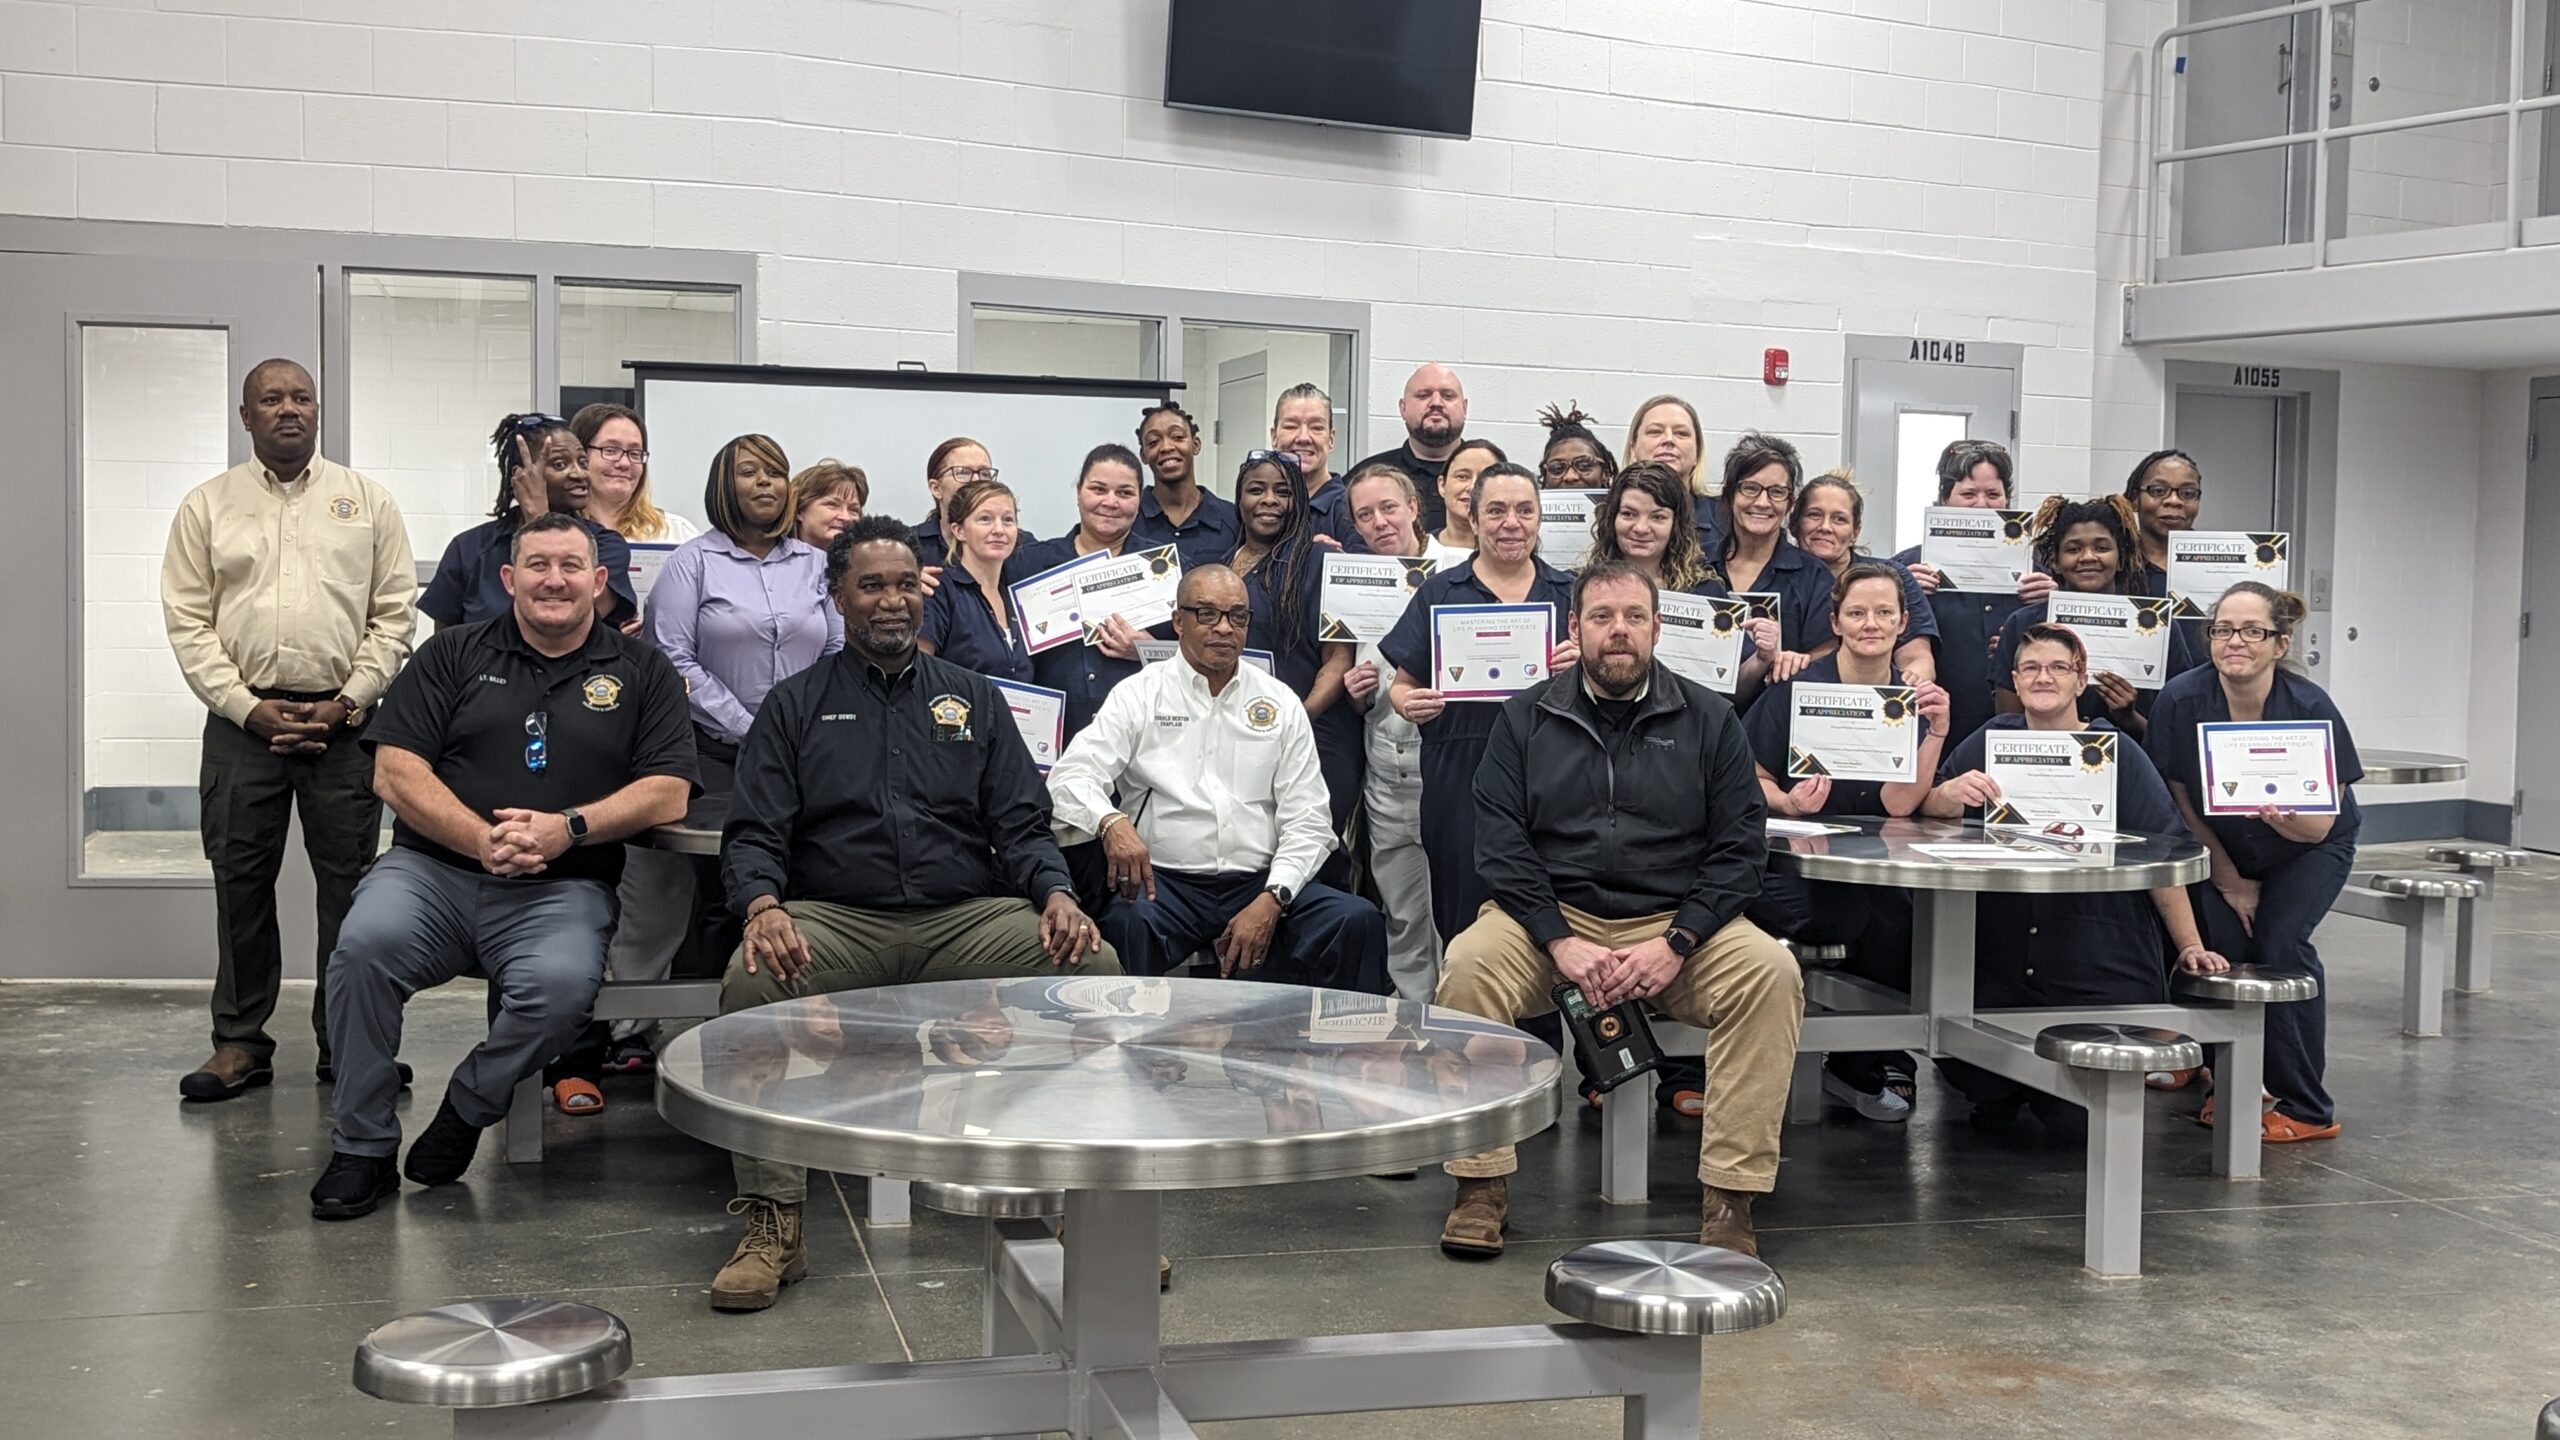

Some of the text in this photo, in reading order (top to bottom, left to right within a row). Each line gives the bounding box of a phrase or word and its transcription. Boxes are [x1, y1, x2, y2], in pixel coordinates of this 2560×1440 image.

[1909, 339, 1965, 363] A1048
[2233, 366, 2280, 387] A1055
[1929, 517, 1994, 528] CERTIFICATE
[2175, 542, 2245, 552] CERTIFICATE
[1078, 563, 1141, 585] CERTIFICATE
[1330, 565, 1396, 576] CERTIFICATE
[1095, 575, 1138, 590] APPRECIATION
[1346, 578, 1391, 586] APPRECIATION
[2056, 603, 2126, 616] CERTIFICATE
[2072, 617, 2120, 626] APPRECIATION
[1799, 694, 1872, 707] CERTIFICATE
[1816, 708, 1867, 717] APPRECIATION
[1994, 743, 2069, 754] CERTIFICATE
[2012, 756, 2064, 764] APPRECIATION
